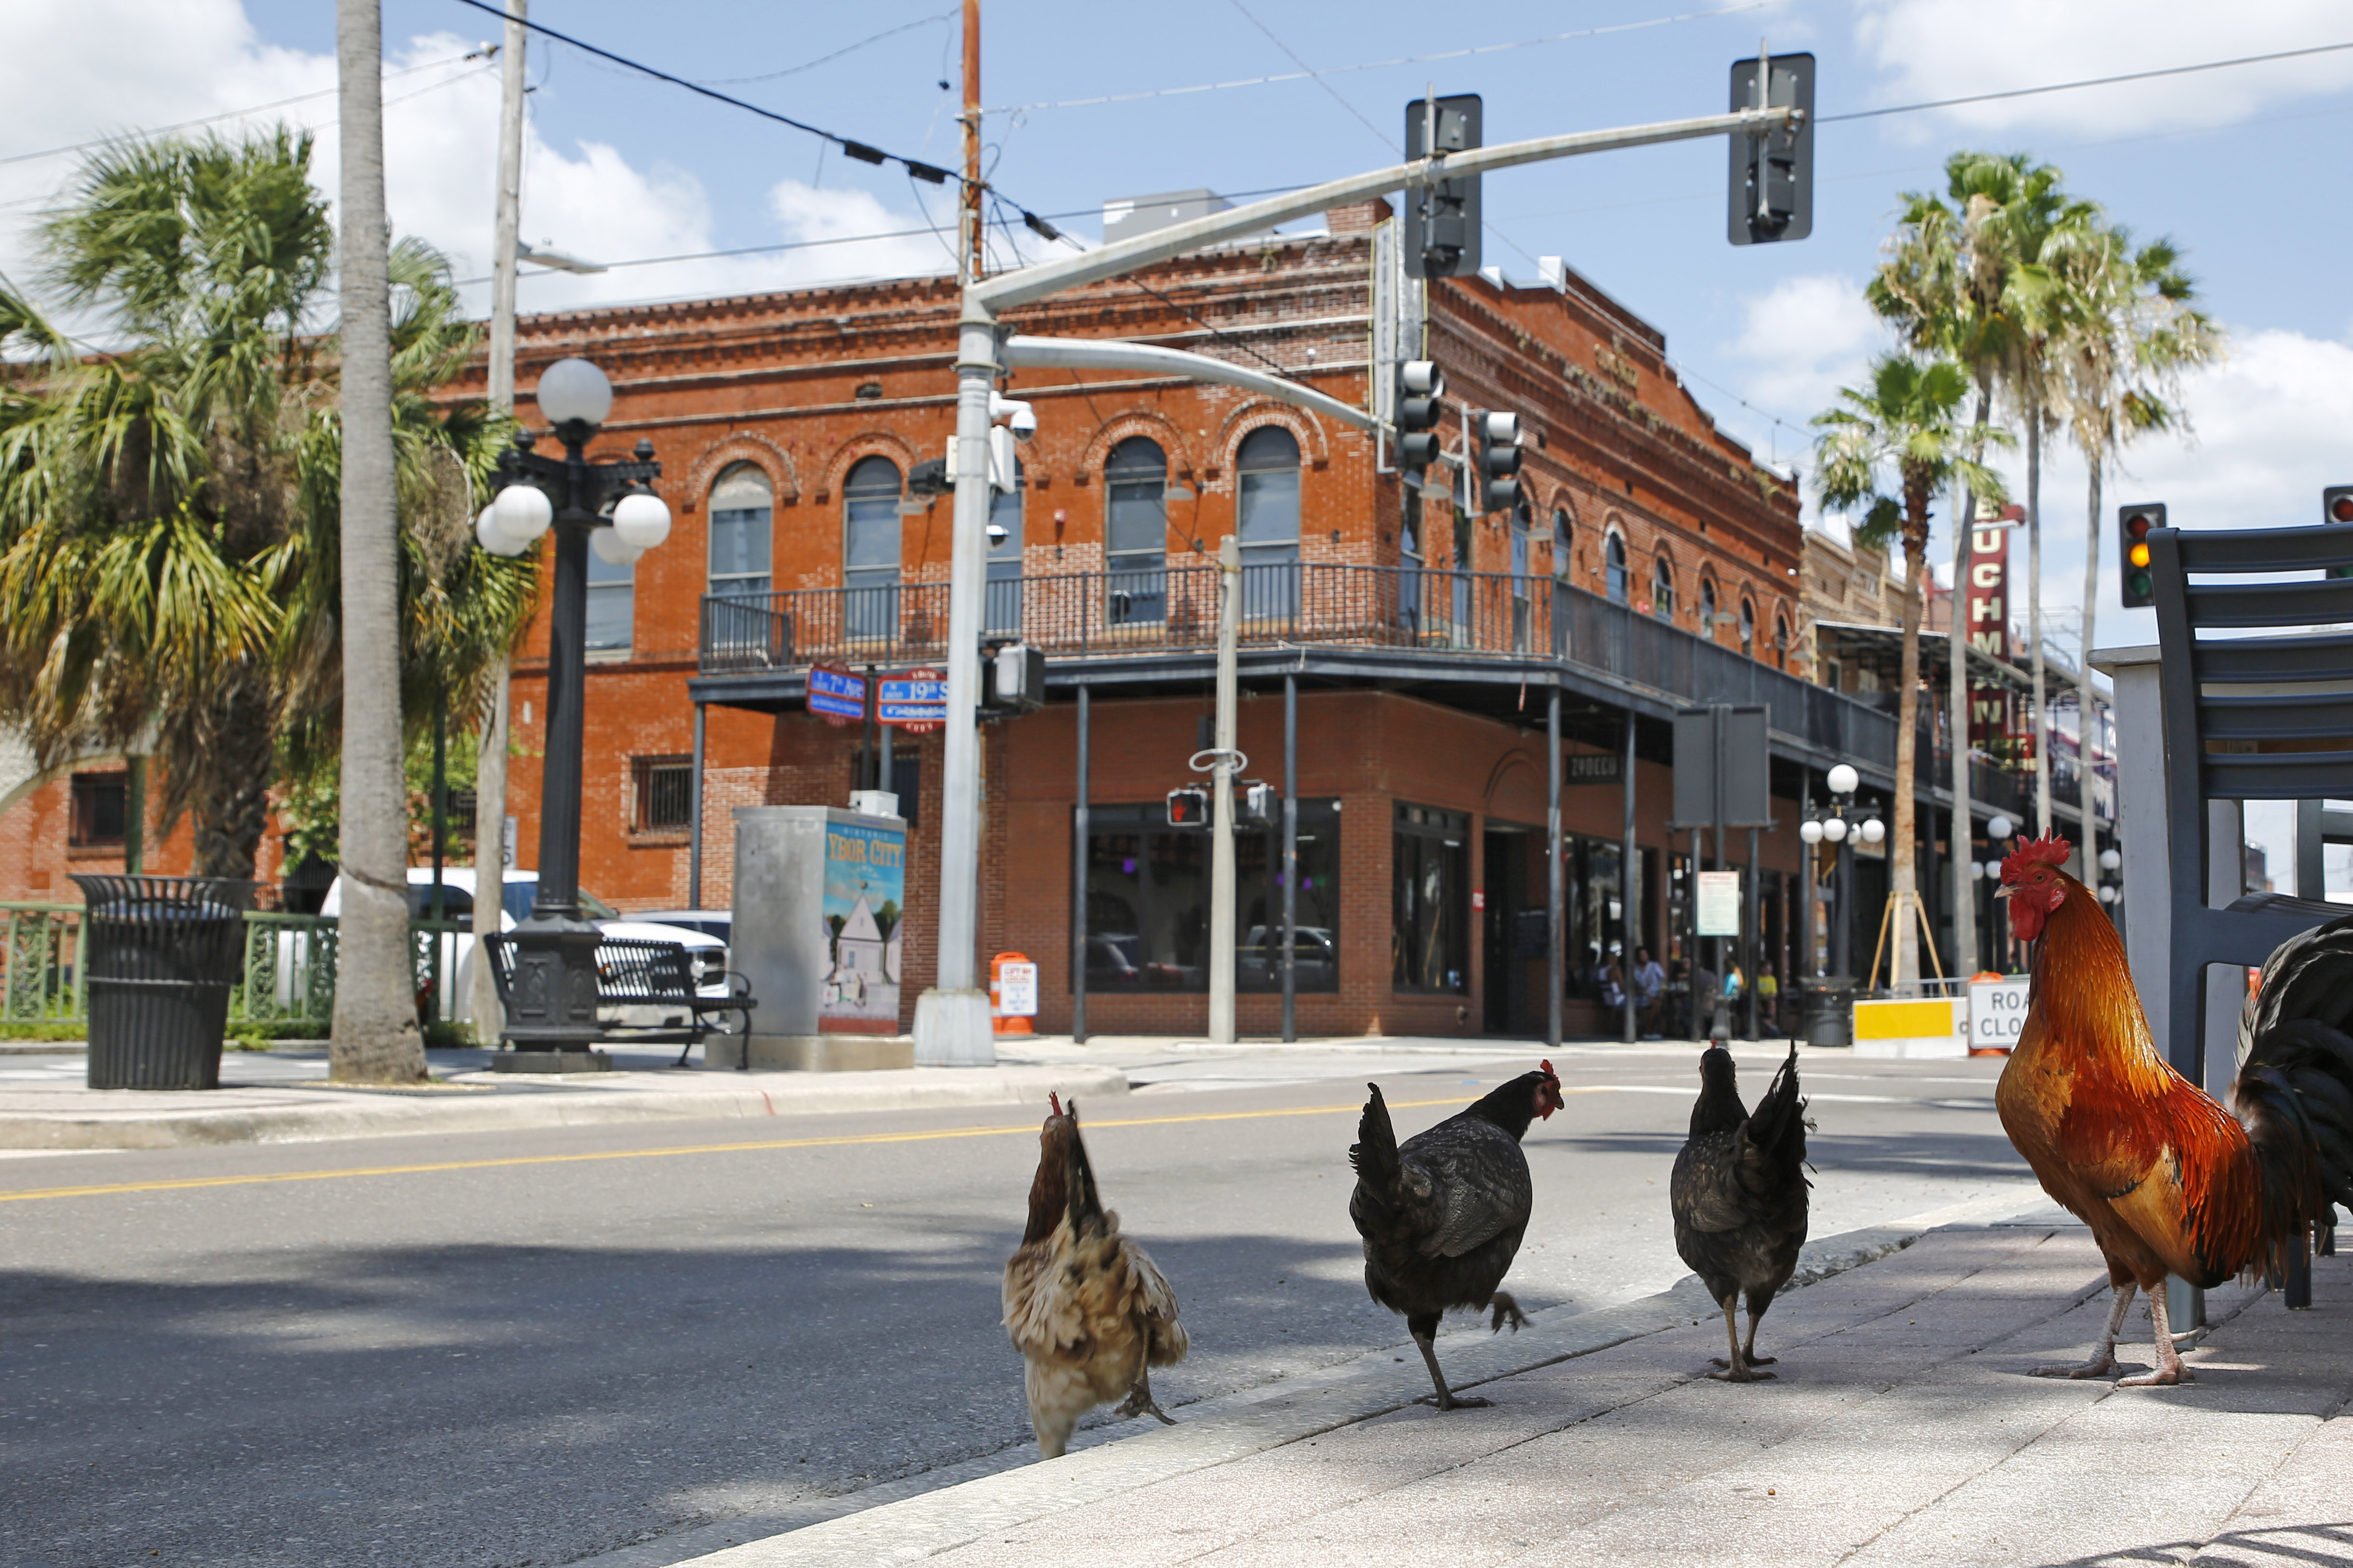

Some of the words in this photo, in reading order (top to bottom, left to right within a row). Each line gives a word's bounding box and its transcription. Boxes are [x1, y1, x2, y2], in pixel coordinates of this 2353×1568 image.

[909, 682, 937, 701] 19th
[939, 681, 949, 701] S
[828, 833, 866, 863] YBOR
[870, 839, 903, 868] CITY
[1992, 992, 2029, 1009] ROA
